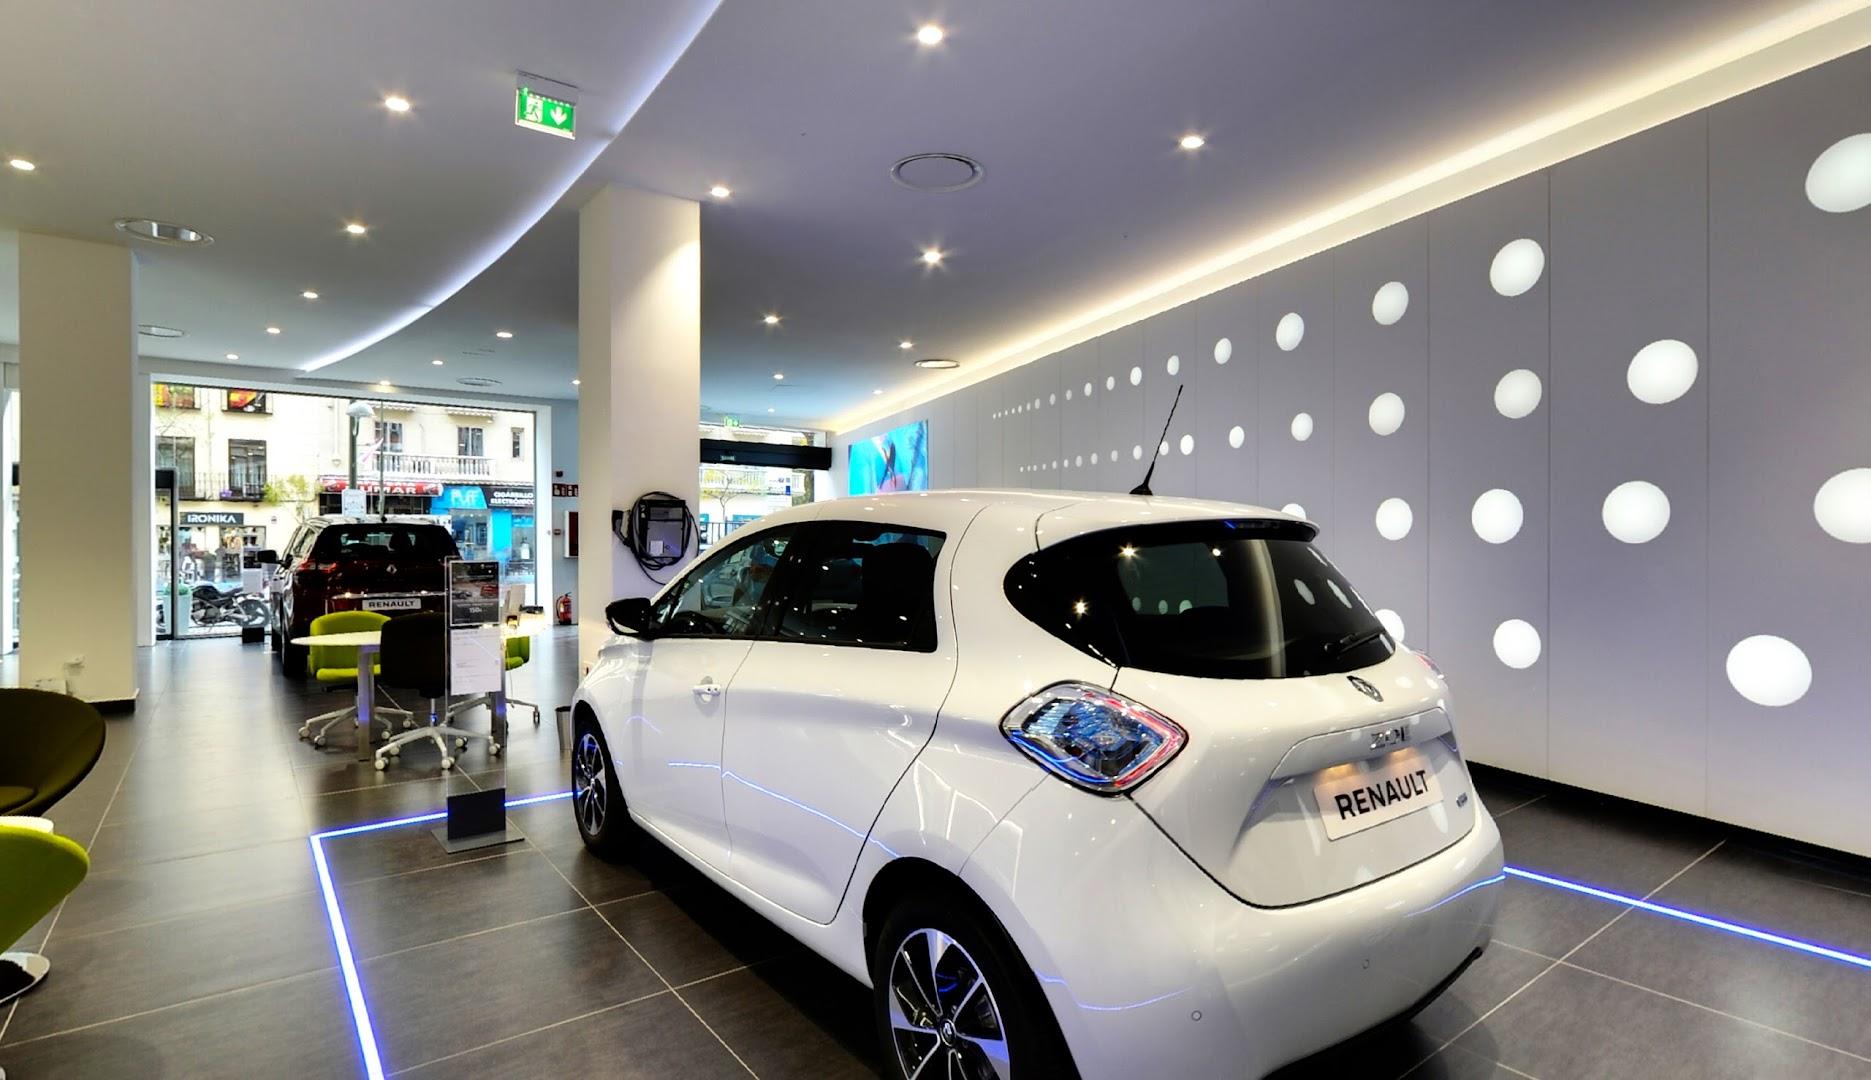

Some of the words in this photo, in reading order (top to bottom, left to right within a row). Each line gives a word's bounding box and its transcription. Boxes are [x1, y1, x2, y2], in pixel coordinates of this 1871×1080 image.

[345, 485, 416, 495] UMAR
[187, 514, 236, 523] IRONIKA
[368, 600, 415, 608] RENAULT
[1334, 770, 1429, 820] RENAULT
